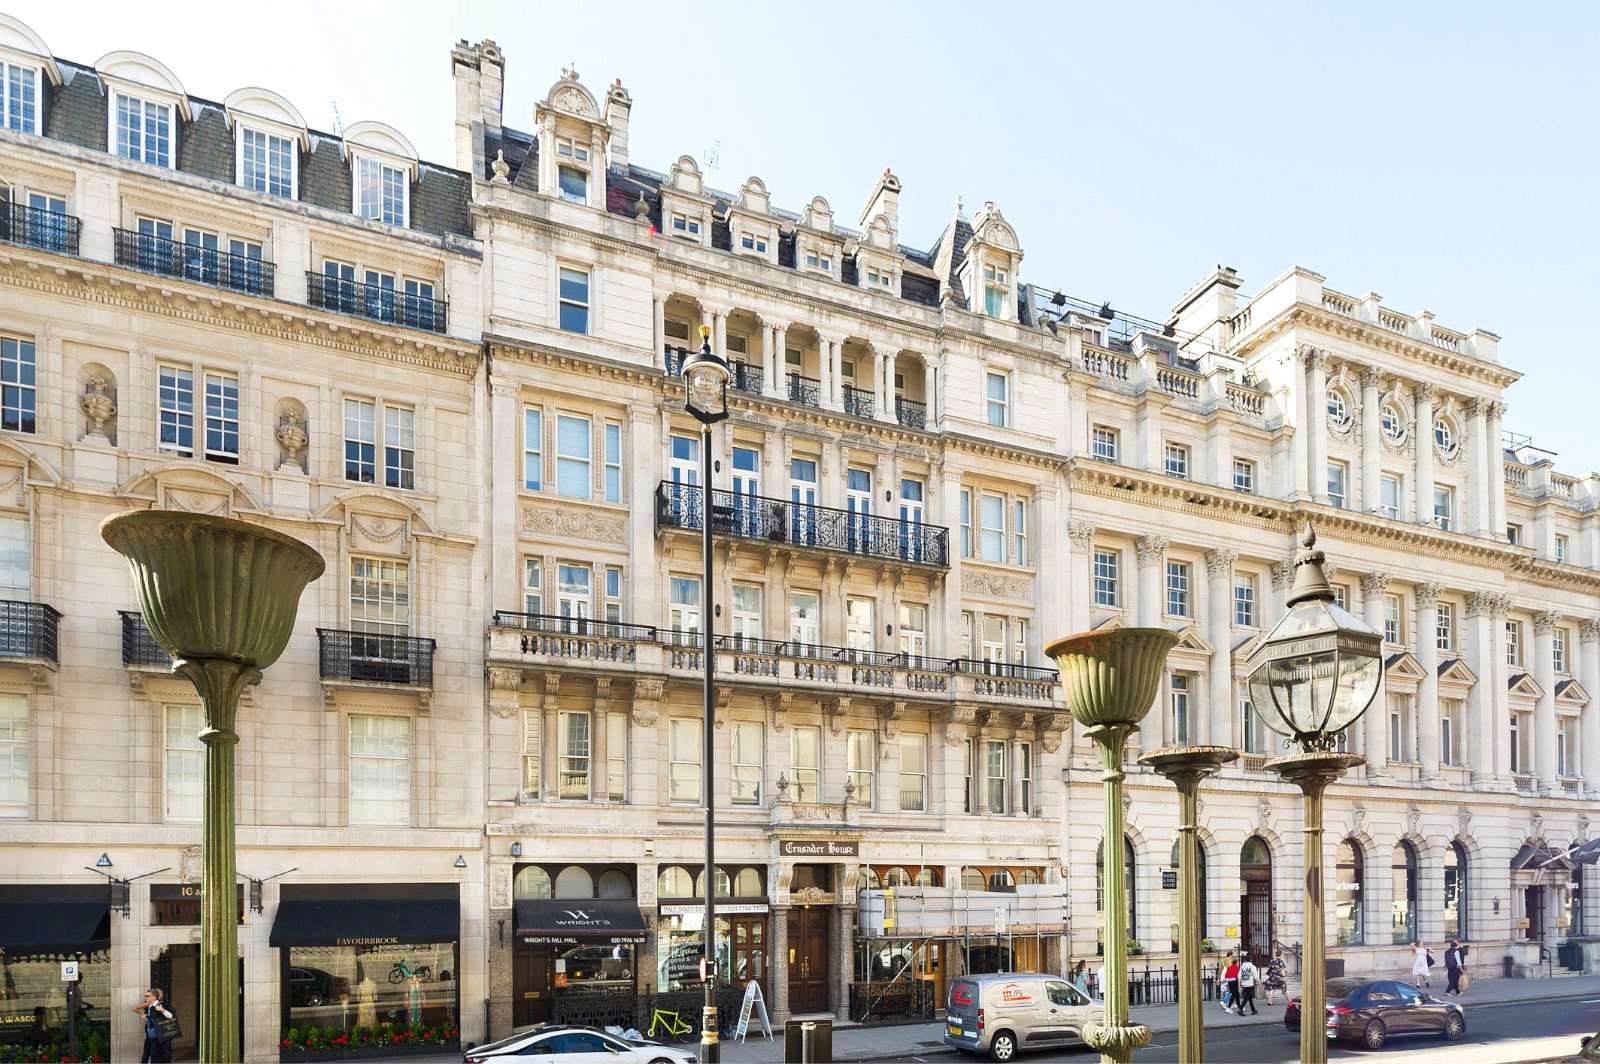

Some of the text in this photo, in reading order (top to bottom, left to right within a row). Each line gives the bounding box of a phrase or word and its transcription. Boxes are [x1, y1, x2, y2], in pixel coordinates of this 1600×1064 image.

[785, 842, 853, 854] Crusader House
[337, 936, 398, 945] FAVOURBROOK
